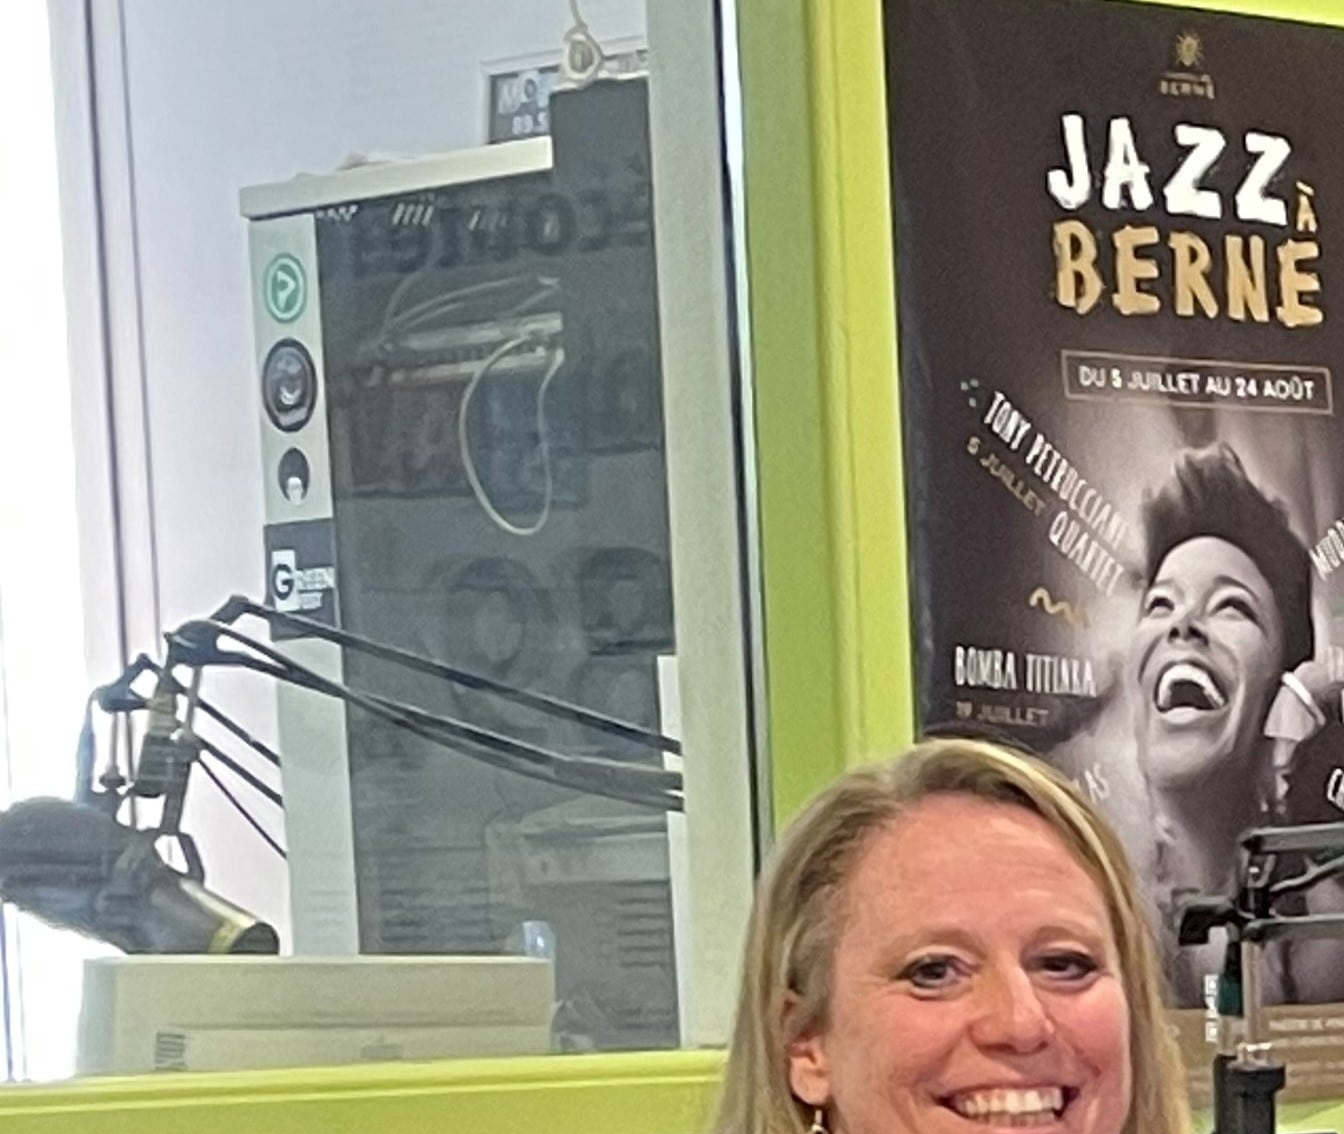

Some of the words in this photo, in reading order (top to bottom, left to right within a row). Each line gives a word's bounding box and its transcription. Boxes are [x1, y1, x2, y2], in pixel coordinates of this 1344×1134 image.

[1047, 113, 1293, 228] JAZZ
[1297, 181, 1318, 232] À
[1050, 218, 1323, 328] BERNE
[983, 391, 1031, 450] TONY
[1079, 365, 1105, 388] DU
[1127, 369, 1201, 394] JUILLET
[1204, 374, 1231, 397] AU
[1236, 376, 1258, 398] 24
[1262, 374, 1314, 401] AOÛT
